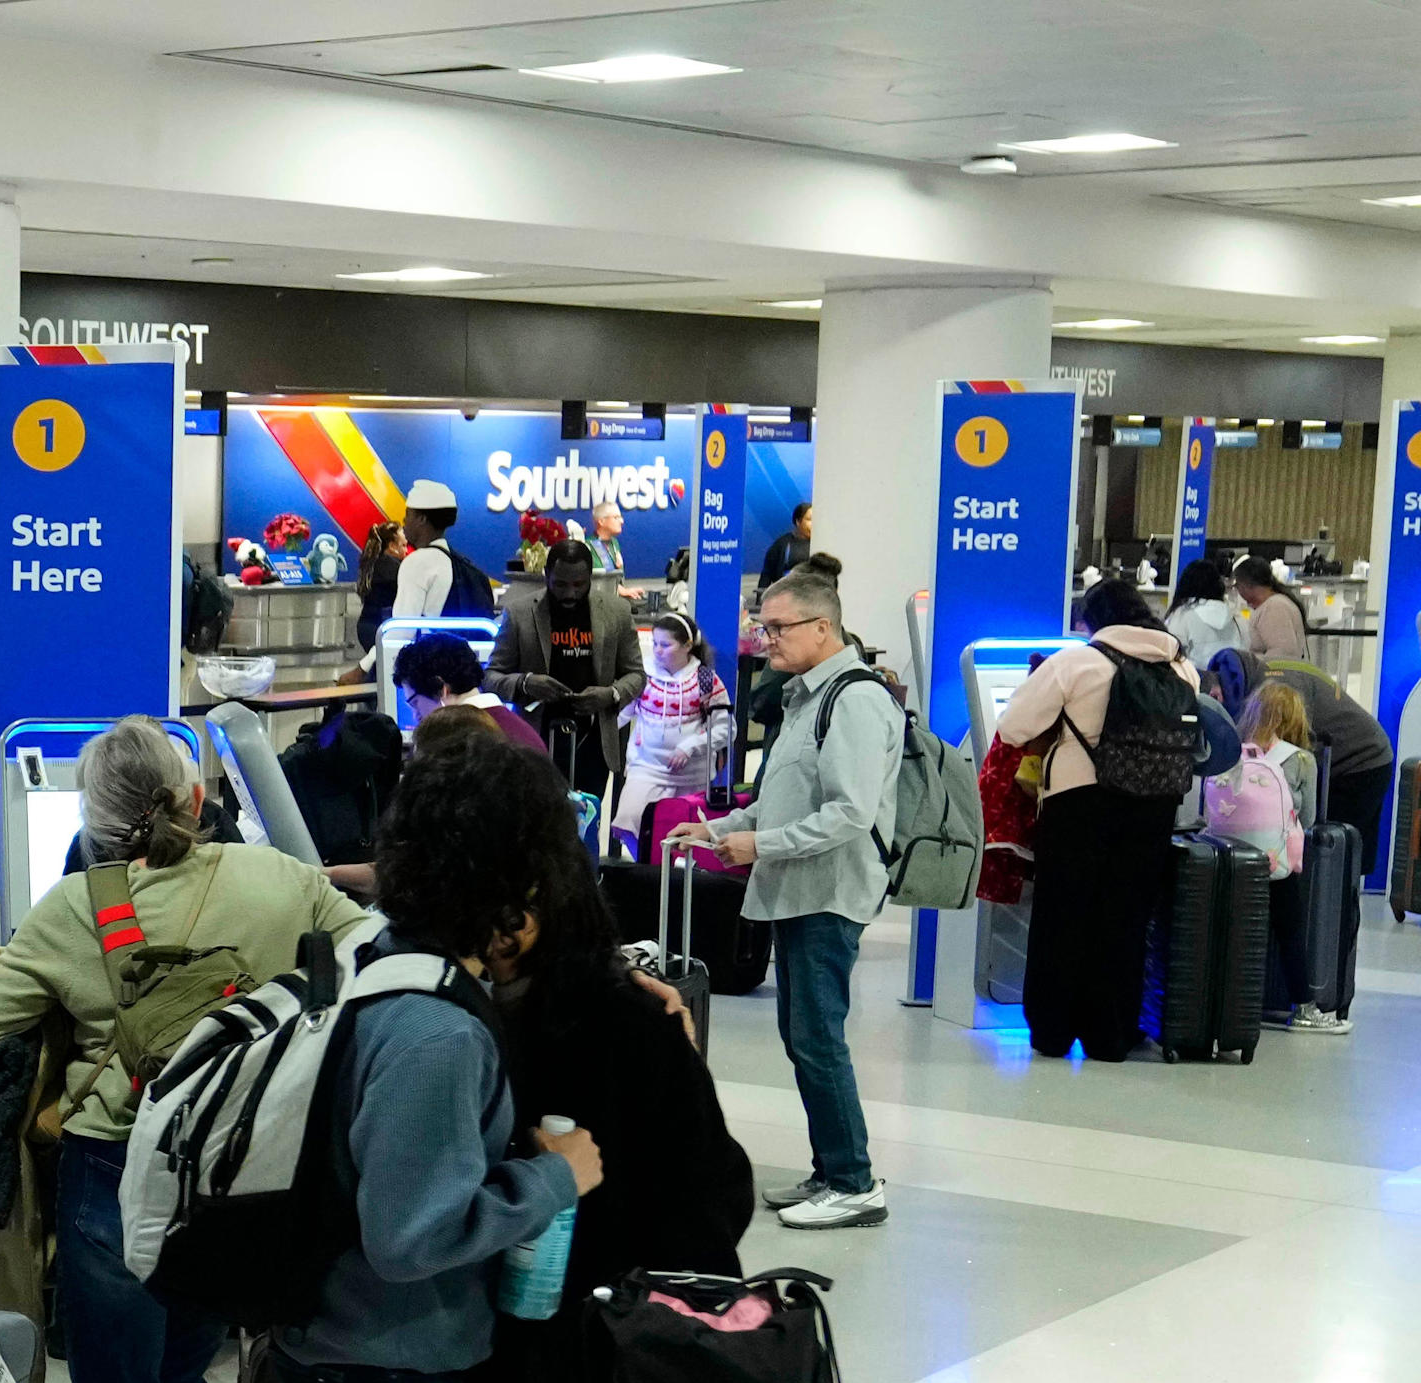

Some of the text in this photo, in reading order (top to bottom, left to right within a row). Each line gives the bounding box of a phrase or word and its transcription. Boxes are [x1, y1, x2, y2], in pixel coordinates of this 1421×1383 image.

[19, 316, 209, 365] OUTHWEST
[38, 417, 54, 453] 1
[975, 430, 987, 454] 1
[486, 449, 670, 512] Southwest
[704, 488, 723, 511] Bag
[953, 495, 1019, 520] Start
[1186, 486, 1198, 505] Bag
[703, 512, 728, 534] Drop
[1185, 504, 1199, 522] Drop
[11, 513, 102, 548] Start
[952, 527, 1019, 552] Here
[11, 560, 103, 592] Here
